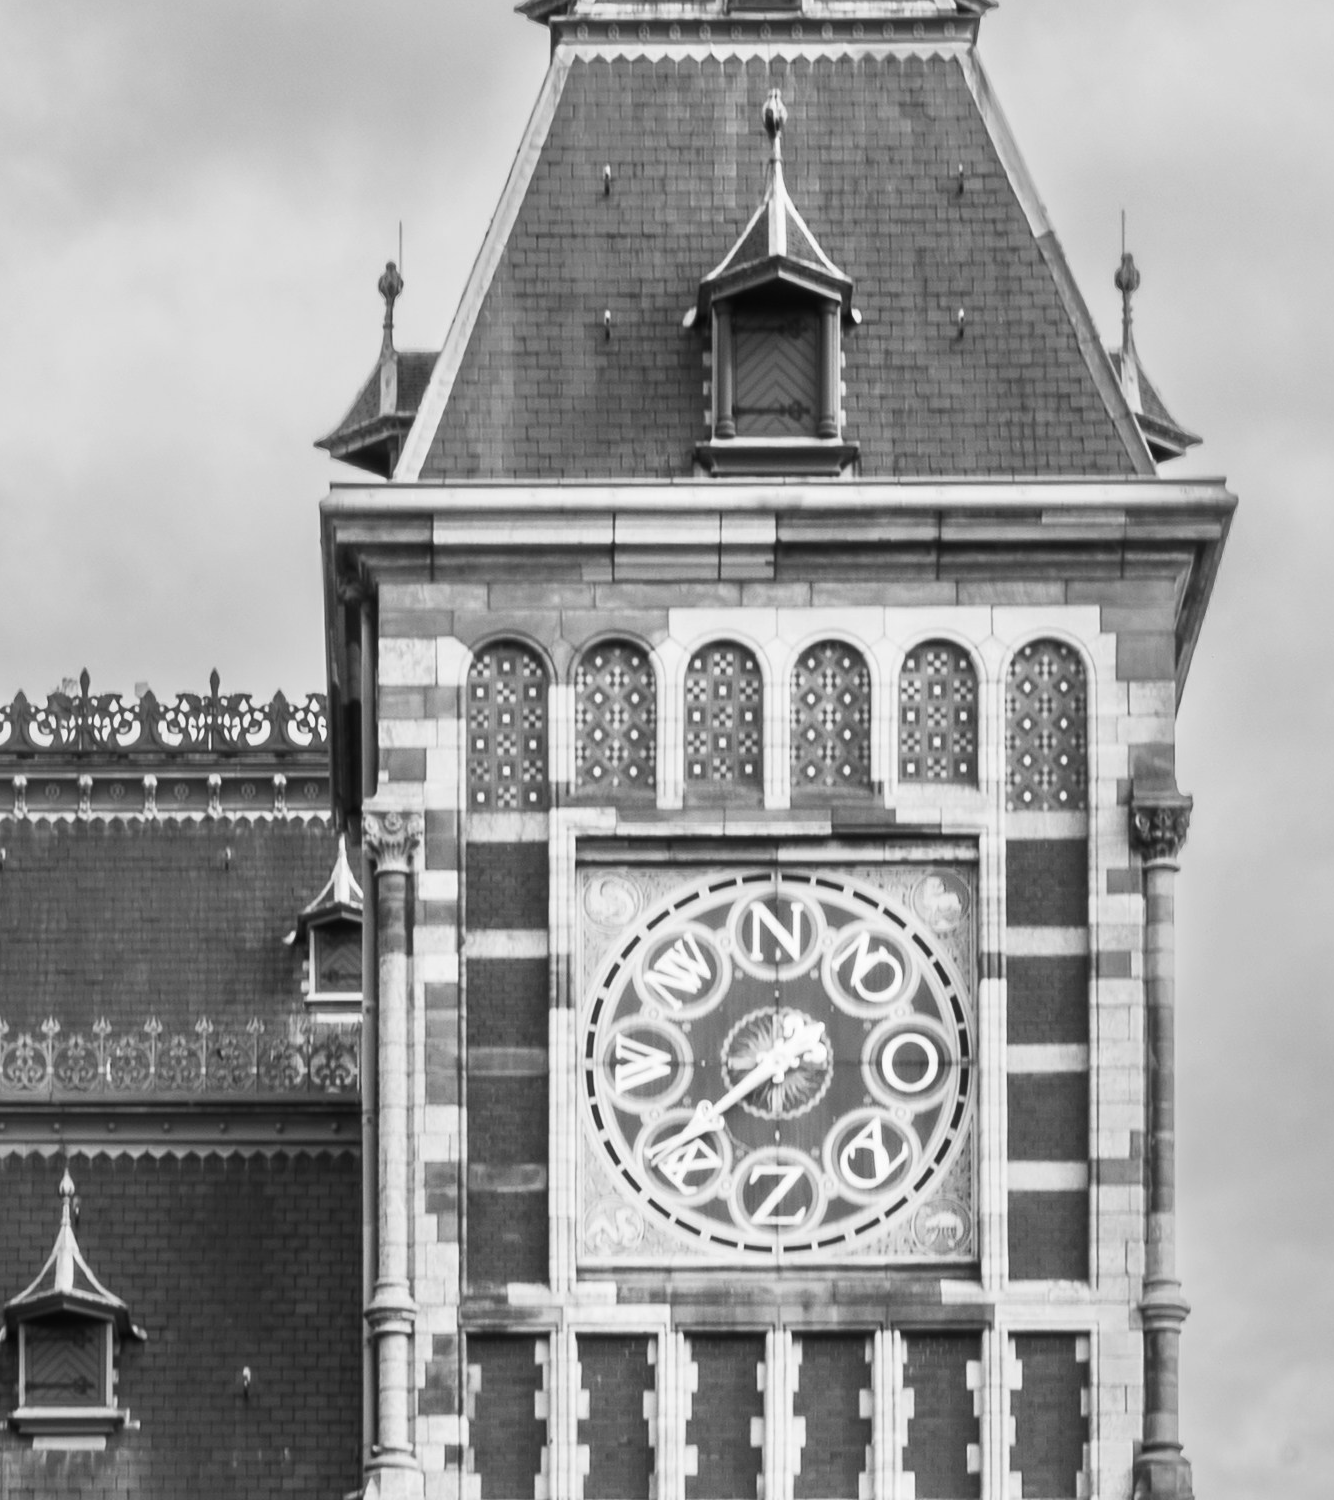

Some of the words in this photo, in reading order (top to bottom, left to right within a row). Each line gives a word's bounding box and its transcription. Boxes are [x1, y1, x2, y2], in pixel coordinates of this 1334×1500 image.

[749, 901, 804, 962] N
[615, 1032, 672, 1095] W
[881, 1032, 939, 1093] O
[748, 1164, 807, 1226] Z
